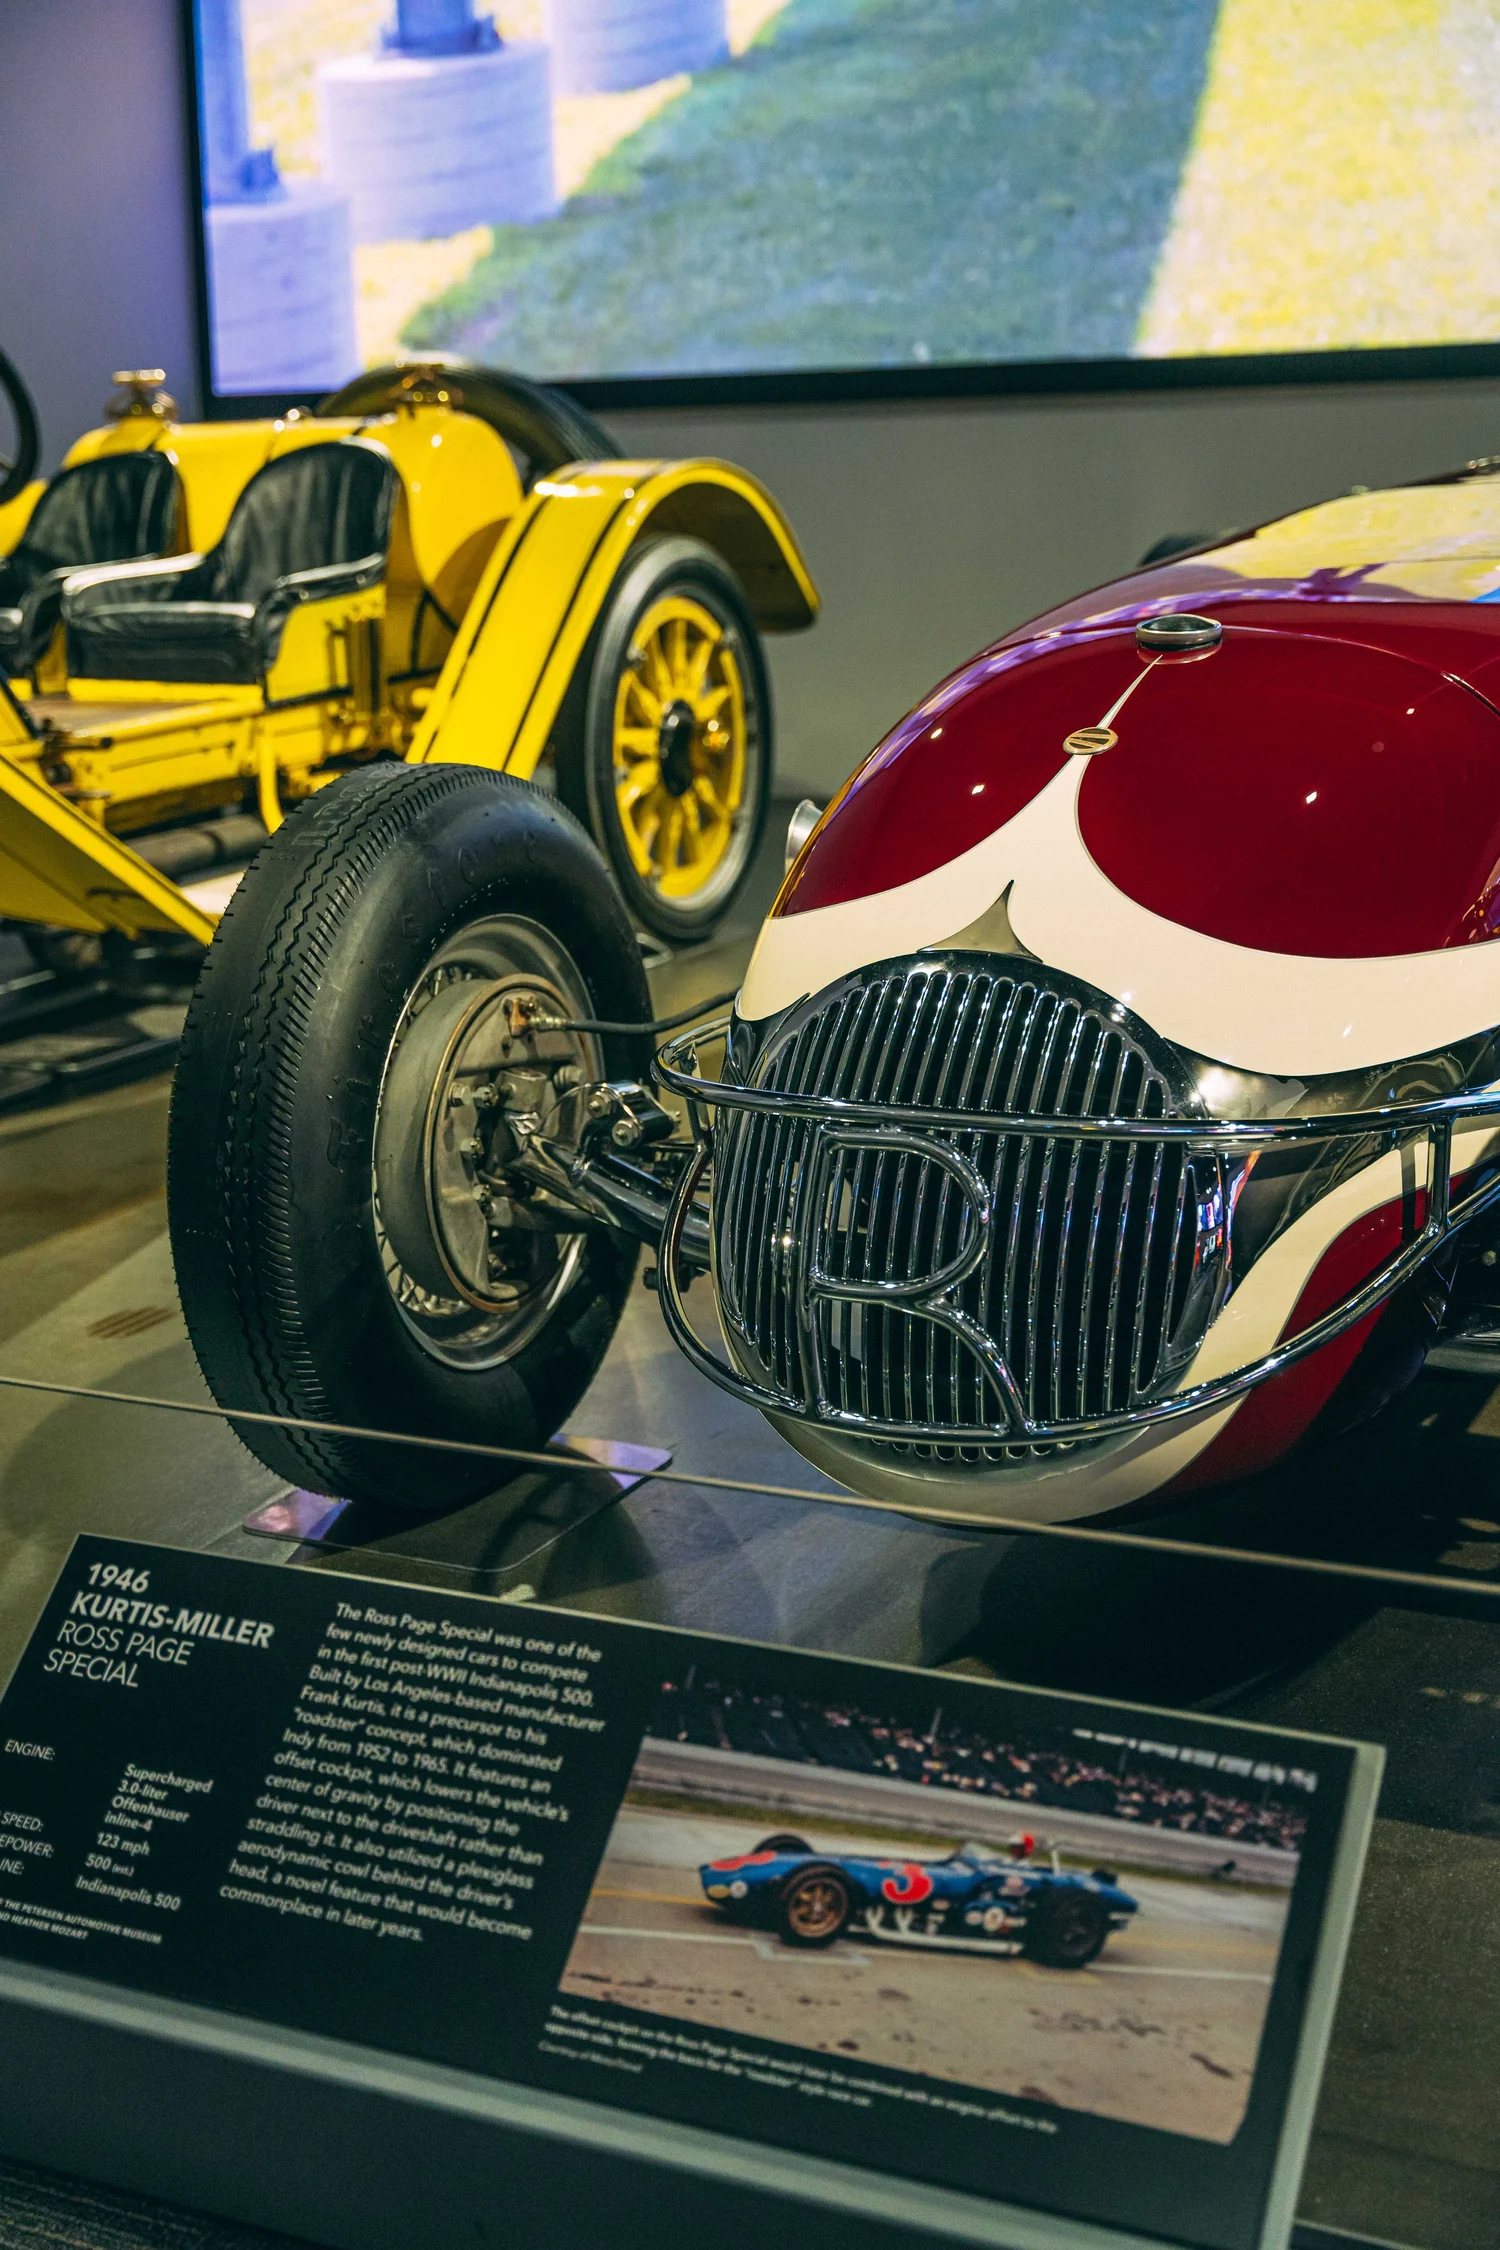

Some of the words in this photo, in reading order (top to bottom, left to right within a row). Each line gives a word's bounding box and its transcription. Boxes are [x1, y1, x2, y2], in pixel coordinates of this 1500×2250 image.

[88, 1563, 150, 1593] 1946
[56, 1619, 123, 1651] ROSS
[124, 1632, 194, 1665] PAGE
[69, 1591, 274, 1648] KURTIS-MILLER
[336, 1603, 362, 1620] The
[364, 1608, 397, 1626] Ross
[399, 1614, 436, 1635] Page
[438, 1621, 493, 1642] Special
[494, 1634, 522, 1648] was
[524, 1638, 555, 1653] one
[556, 1643, 576, 1656] of
[575, 1645, 601, 1662] the
[43, 1648, 137, 1687] SPECIAL
[317, 1644, 331, 1658] in
[333, 1647, 358, 1664] the
[360, 1651, 388, 1669] first
[388, 1660, 468, 1683] post-WWII
[468, 1670, 558, 1700] Indianapolis
[326, 1623, 352, 1640] few
[353, 1631, 396, 1651] newly
[397, 1636, 467, 1660] designed
[467, 1651, 498, 1667] cars
[501, 1655, 518, 1670] to
[519, 1660, 588, 1682] compete
[300, 1684, 339, 1705] Frank
[390, 1703, 402, 1717] it
[403, 1708, 416, 1720] is
[417, 1711, 428, 1722] a
[429, 1713, 503, 1735] precursor
[505, 1725, 522, 1740] to
[524, 1727, 546, 1745] his
[308, 1664, 342, 1683] Built
[342, 1670, 362, 1690] by
[363, 1674, 389, 1692] Los
[390, 1680, 503, 1713] Angeles-based
[503, 1703, 605, 1731] manufacturer
[3, 1738, 55, 1759] ENGINE:
[282, 1727, 315, 1749] Indy
[316, 1733, 351, 1753] from
[356, 1741, 391, 1761] 1952
[391, 1750, 408, 1765] to
[413, 1752, 447, 1773] 1965.
[453, 1761, 465, 1776] It
[467, 1763, 528, 1789] features
[530, 1779, 551, 1793] an
[431, 1735, 475, 1754] which
[477, 1742, 562, 1771] dominated
[117, 1778, 167, 1800] 3.0-liter
[124, 1763, 213, 1792] Supercharged
[273, 1751, 316, 1770] offset
[317, 1761, 372, 1783] cockpit,
[378, 1772, 421, 1791] which
[423, 1779, 472, 1802] lowers
[475, 1790, 501, 1808] the
[504, 1798, 568, 1821] vehicle's
[0, 1810, 43, 1831] SPEED:
[103, 1810, 152, 1831] inline-4
[111, 1794, 189, 1821] Offenhauser
[264, 1774, 311, 1792] center
[313, 1782, 332, 1796] of
[330, 1787, 382, 1810] gravity
[383, 1795, 404, 1815] by
[404, 1802, 491, 1833] positioning
[493, 1817, 519, 1836] the
[97, 1832, 120, 1848] 123
[120, 1840, 150, 1855] mph
[255, 1794, 299, 1813] driver
[300, 1805, 334, 1821] next
[335, 1810, 352, 1825] to
[354, 1813, 379, 1831] the
[381, 1819, 457, 1847] driveshaft
[458, 1837, 505, 1856] rather
[507, 1845, 543, 1865] than
[84, 1852, 112, 1870] 500
[237, 1840, 331, 1870] aerodynamic
[333, 1861, 371, 1877] cowl
[370, 1865, 427, 1890] behind
[427, 1878, 453, 1896] the
[455, 1884, 513, 1910] driver's
[246, 1818, 321, 1847] straddling
[340, 1834, 352, 1850] It
[353, 1839, 385, 1857] also
[387, 1847, 444, 1869] utilized
[443, 1859, 455, 1871] a
[455, 1861, 533, 1889] plexiglass
[75, 1875, 152, 1904] Indianapolis
[153, 1892, 181, 1910] 500
[879, 1861, 934, 1904] 3
[4, 1898, 21, 1910] THE
[21, 1903, 63, 1920] PETERSEN
[63, 1913, 121, 1934] AUTOMOTIVE
[121, 1927, 161, 1943] MUSEUM
[10, 1914, 50, 1930] HEATHER
[219, 1885, 323, 1918] commonplace
[325, 1906, 340, 1921] in
[342, 1909, 378, 1929] later
[377, 1921, 422, 1940] years.
[271, 1872, 282, 1884] a
[284, 1874, 327, 1893] novel
[328, 1881, 381, 1906] feature
[383, 1894, 414, 1913] that
[416, 1904, 466, 1924] would
[466, 1911, 532, 1939] become
